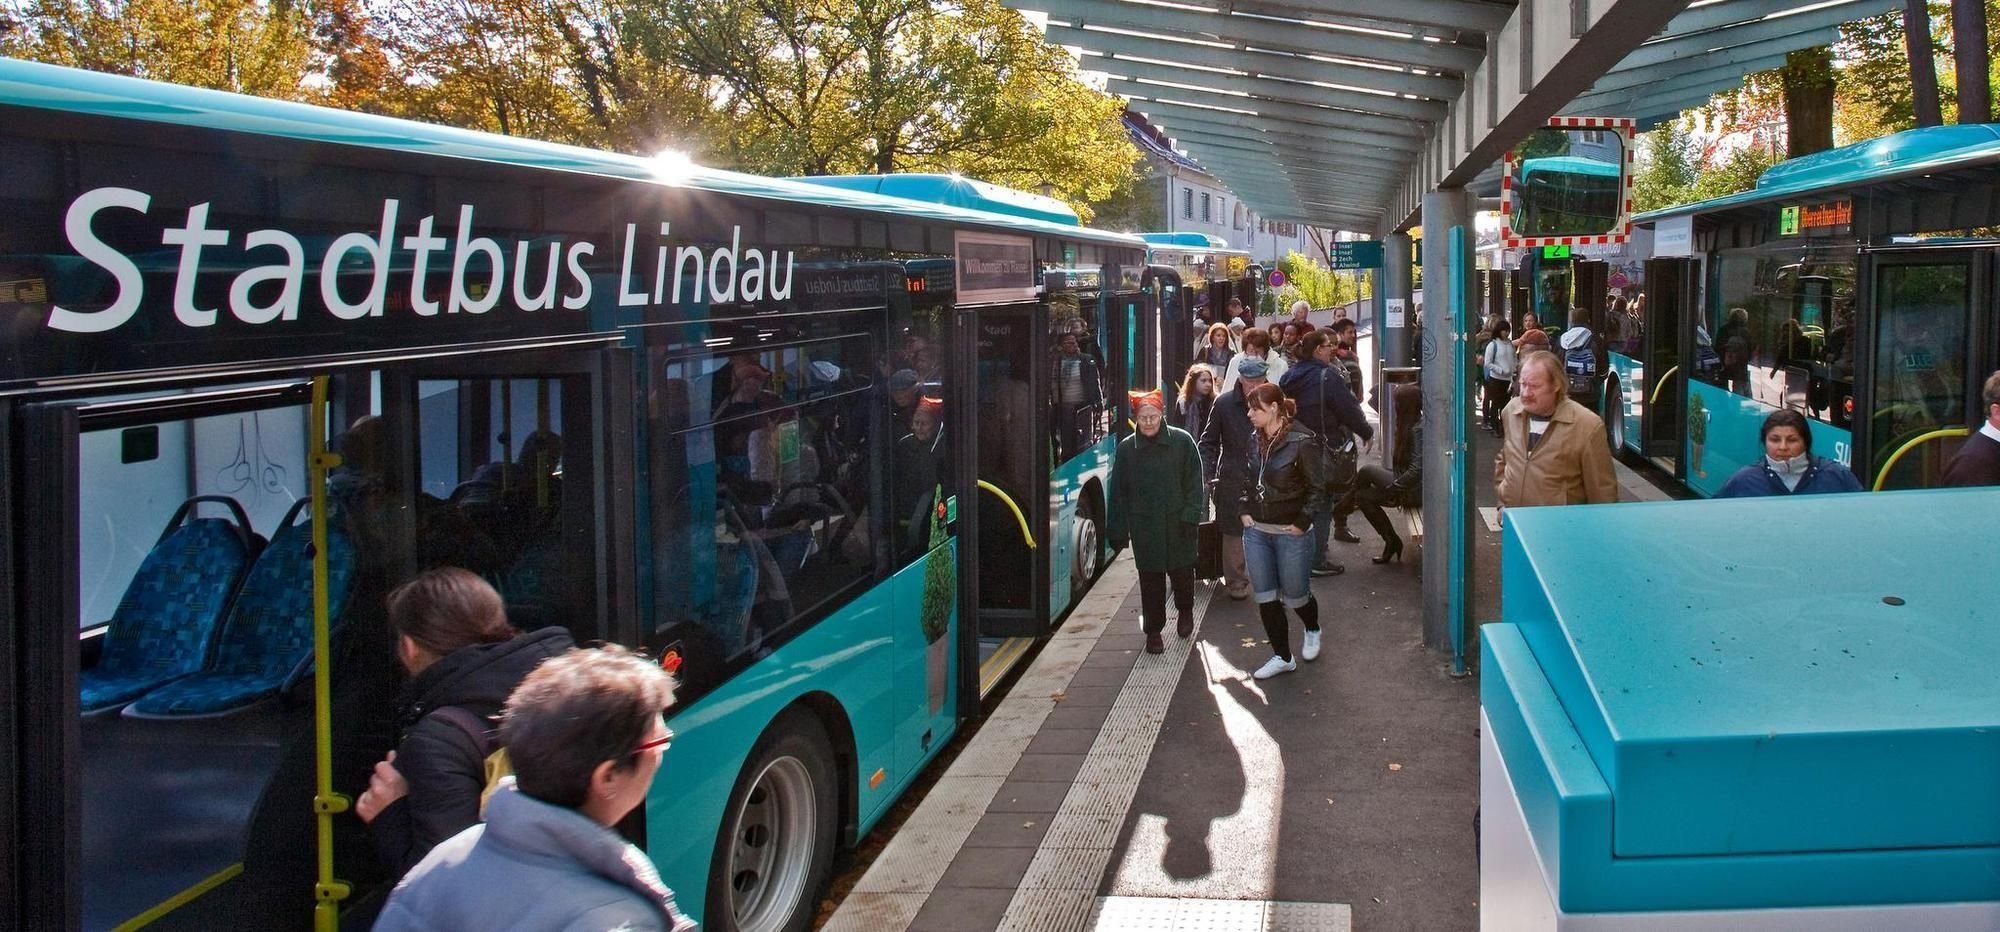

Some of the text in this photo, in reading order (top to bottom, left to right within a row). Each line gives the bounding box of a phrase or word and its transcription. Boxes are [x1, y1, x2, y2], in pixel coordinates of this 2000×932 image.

[47, 186, 794, 333] Stadtbus Lindau
[1552, 245, 1561, 257] 2
